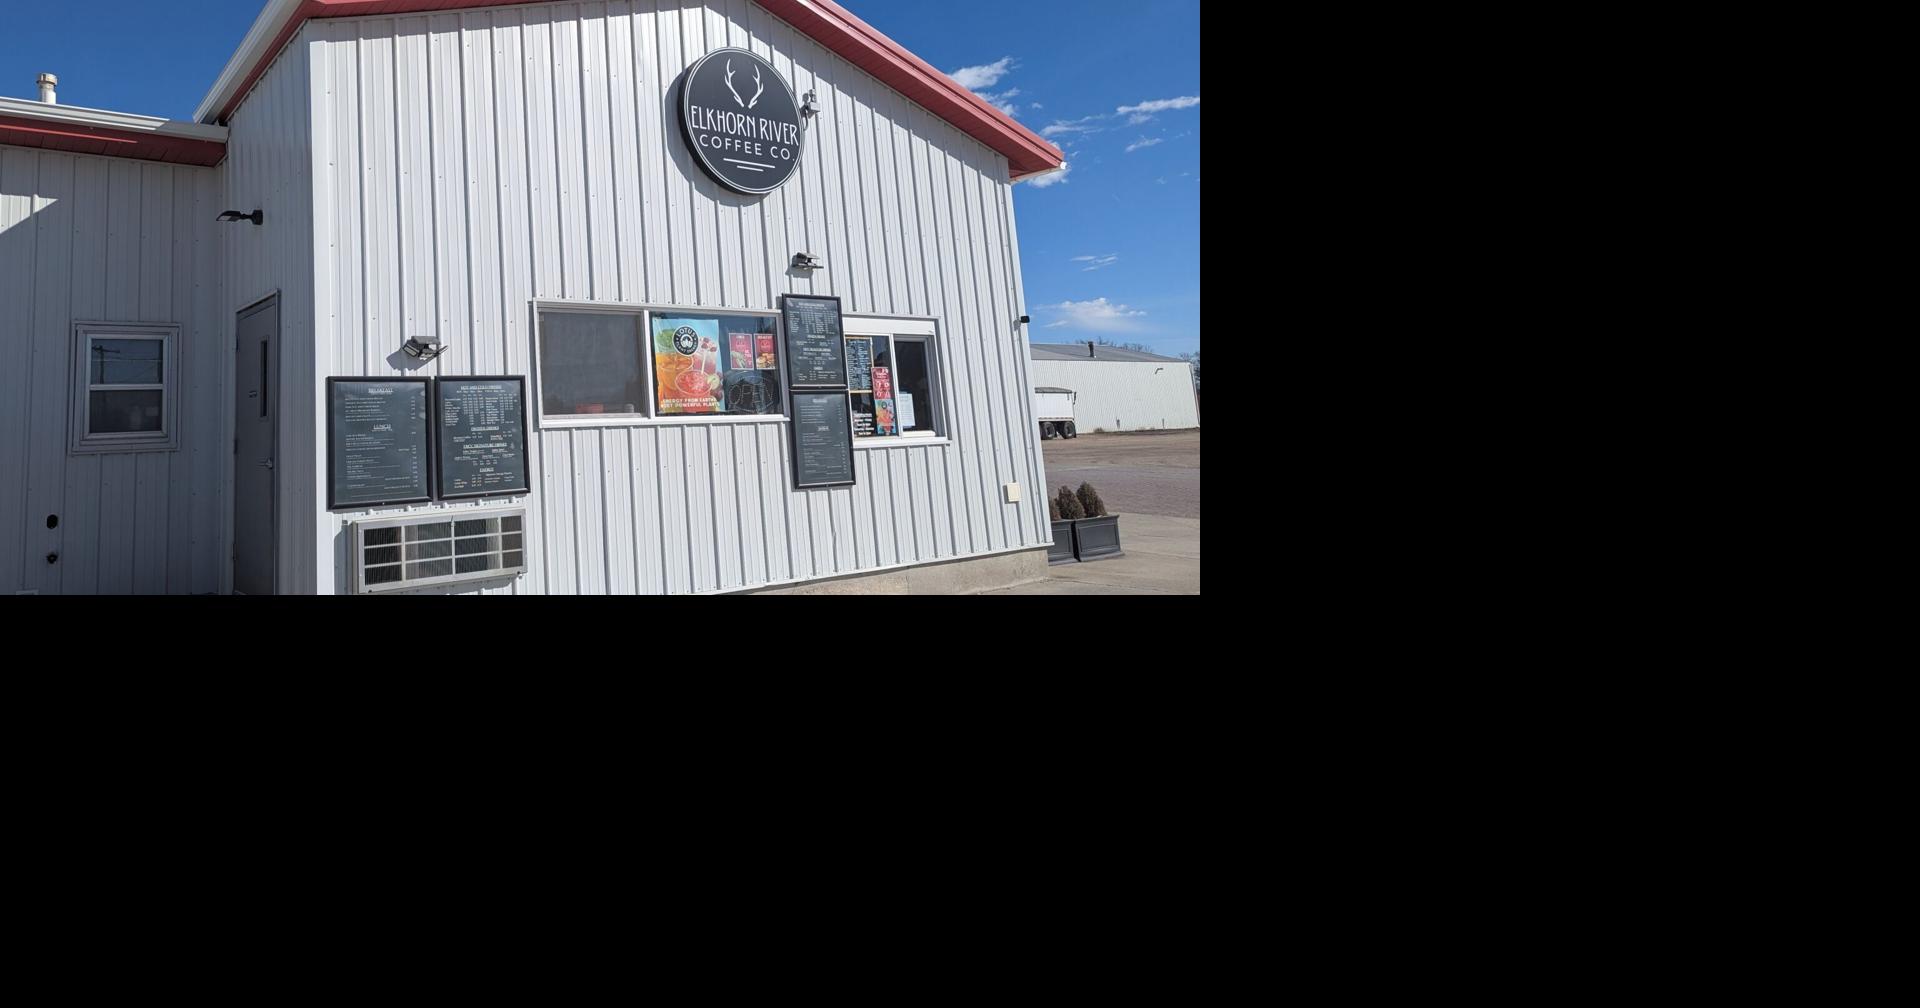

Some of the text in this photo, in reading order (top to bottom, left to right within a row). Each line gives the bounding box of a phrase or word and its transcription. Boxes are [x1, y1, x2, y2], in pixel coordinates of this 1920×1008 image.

[691, 105, 799, 146] ELKHORN RIVER
[699, 134, 795, 162] COFFEE CO.
[675, 327, 696, 338] LOTUS
